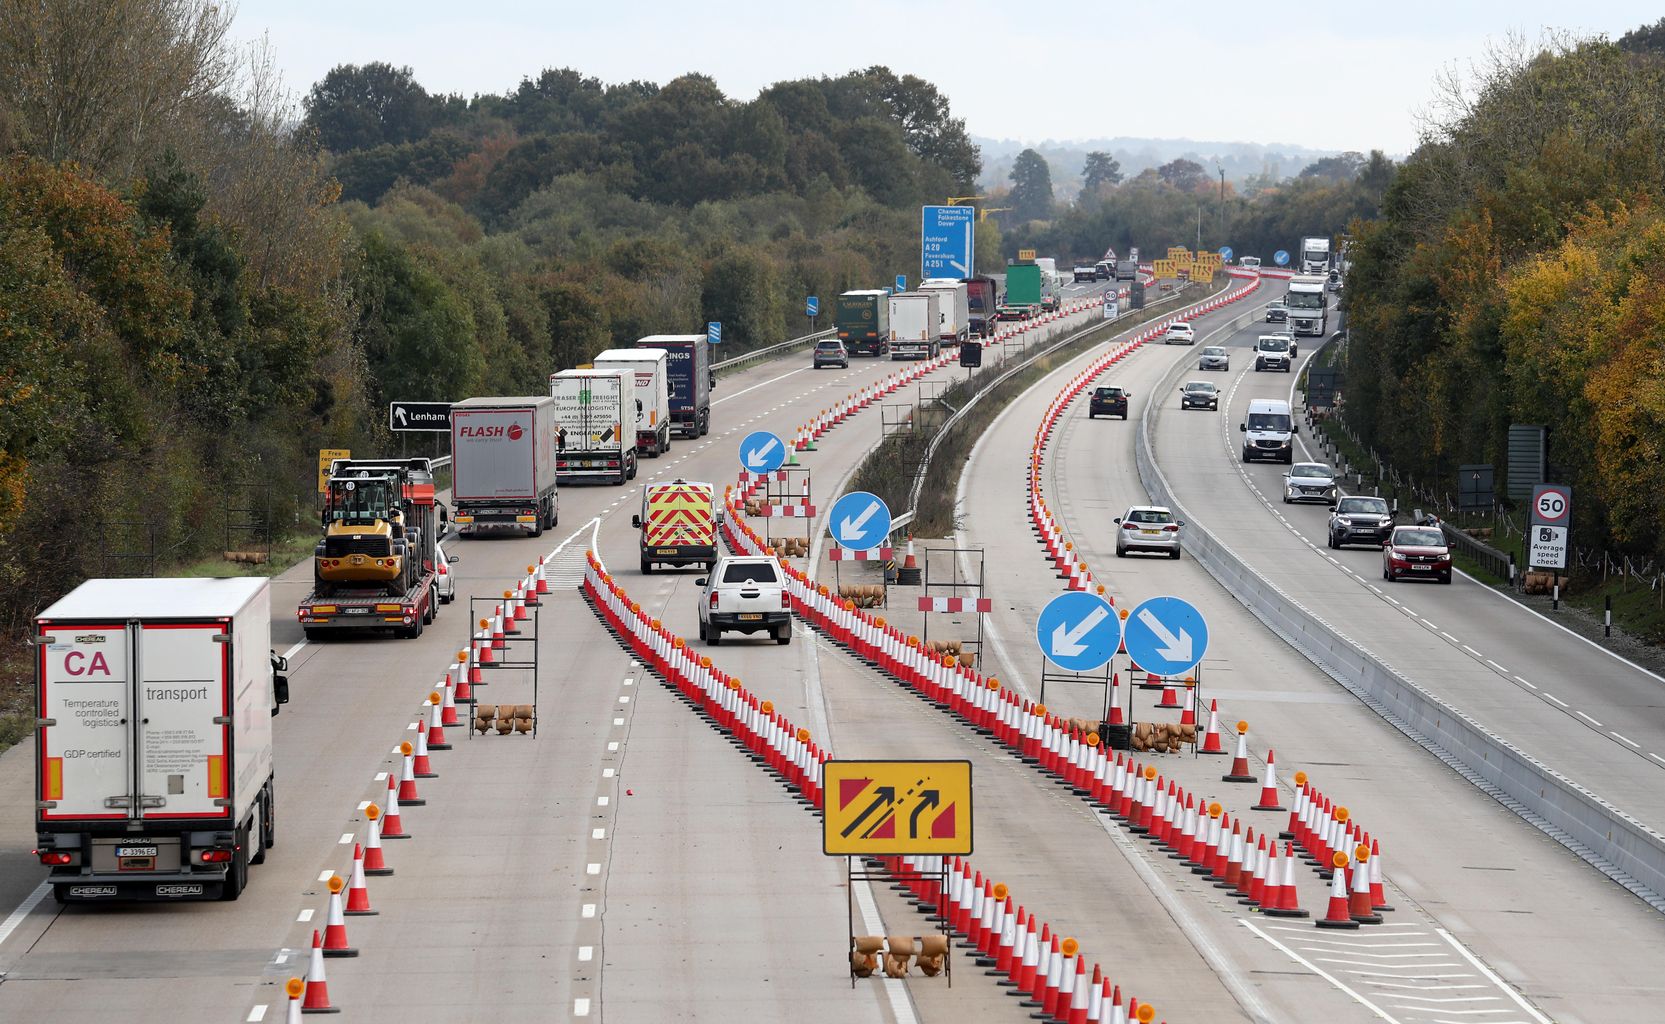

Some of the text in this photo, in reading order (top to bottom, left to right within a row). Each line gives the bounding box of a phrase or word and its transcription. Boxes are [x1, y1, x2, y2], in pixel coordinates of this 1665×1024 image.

[410, 412, 446, 421] Lenham
[460, 426, 505, 437] FLASH
[1540, 499, 1564, 513] 50
[1533, 543, 1564, 552] Average
[1537, 551, 1559, 559] speed
[1536, 558, 1559, 566] check
[64, 651, 111, 676] CA
[147, 687, 207, 702] transport
[63, 699, 119, 709] Temperature
[75, 709, 119, 717] controlled
[82, 719, 119, 728] logistics
[64, 750, 121, 758] GDP certified
